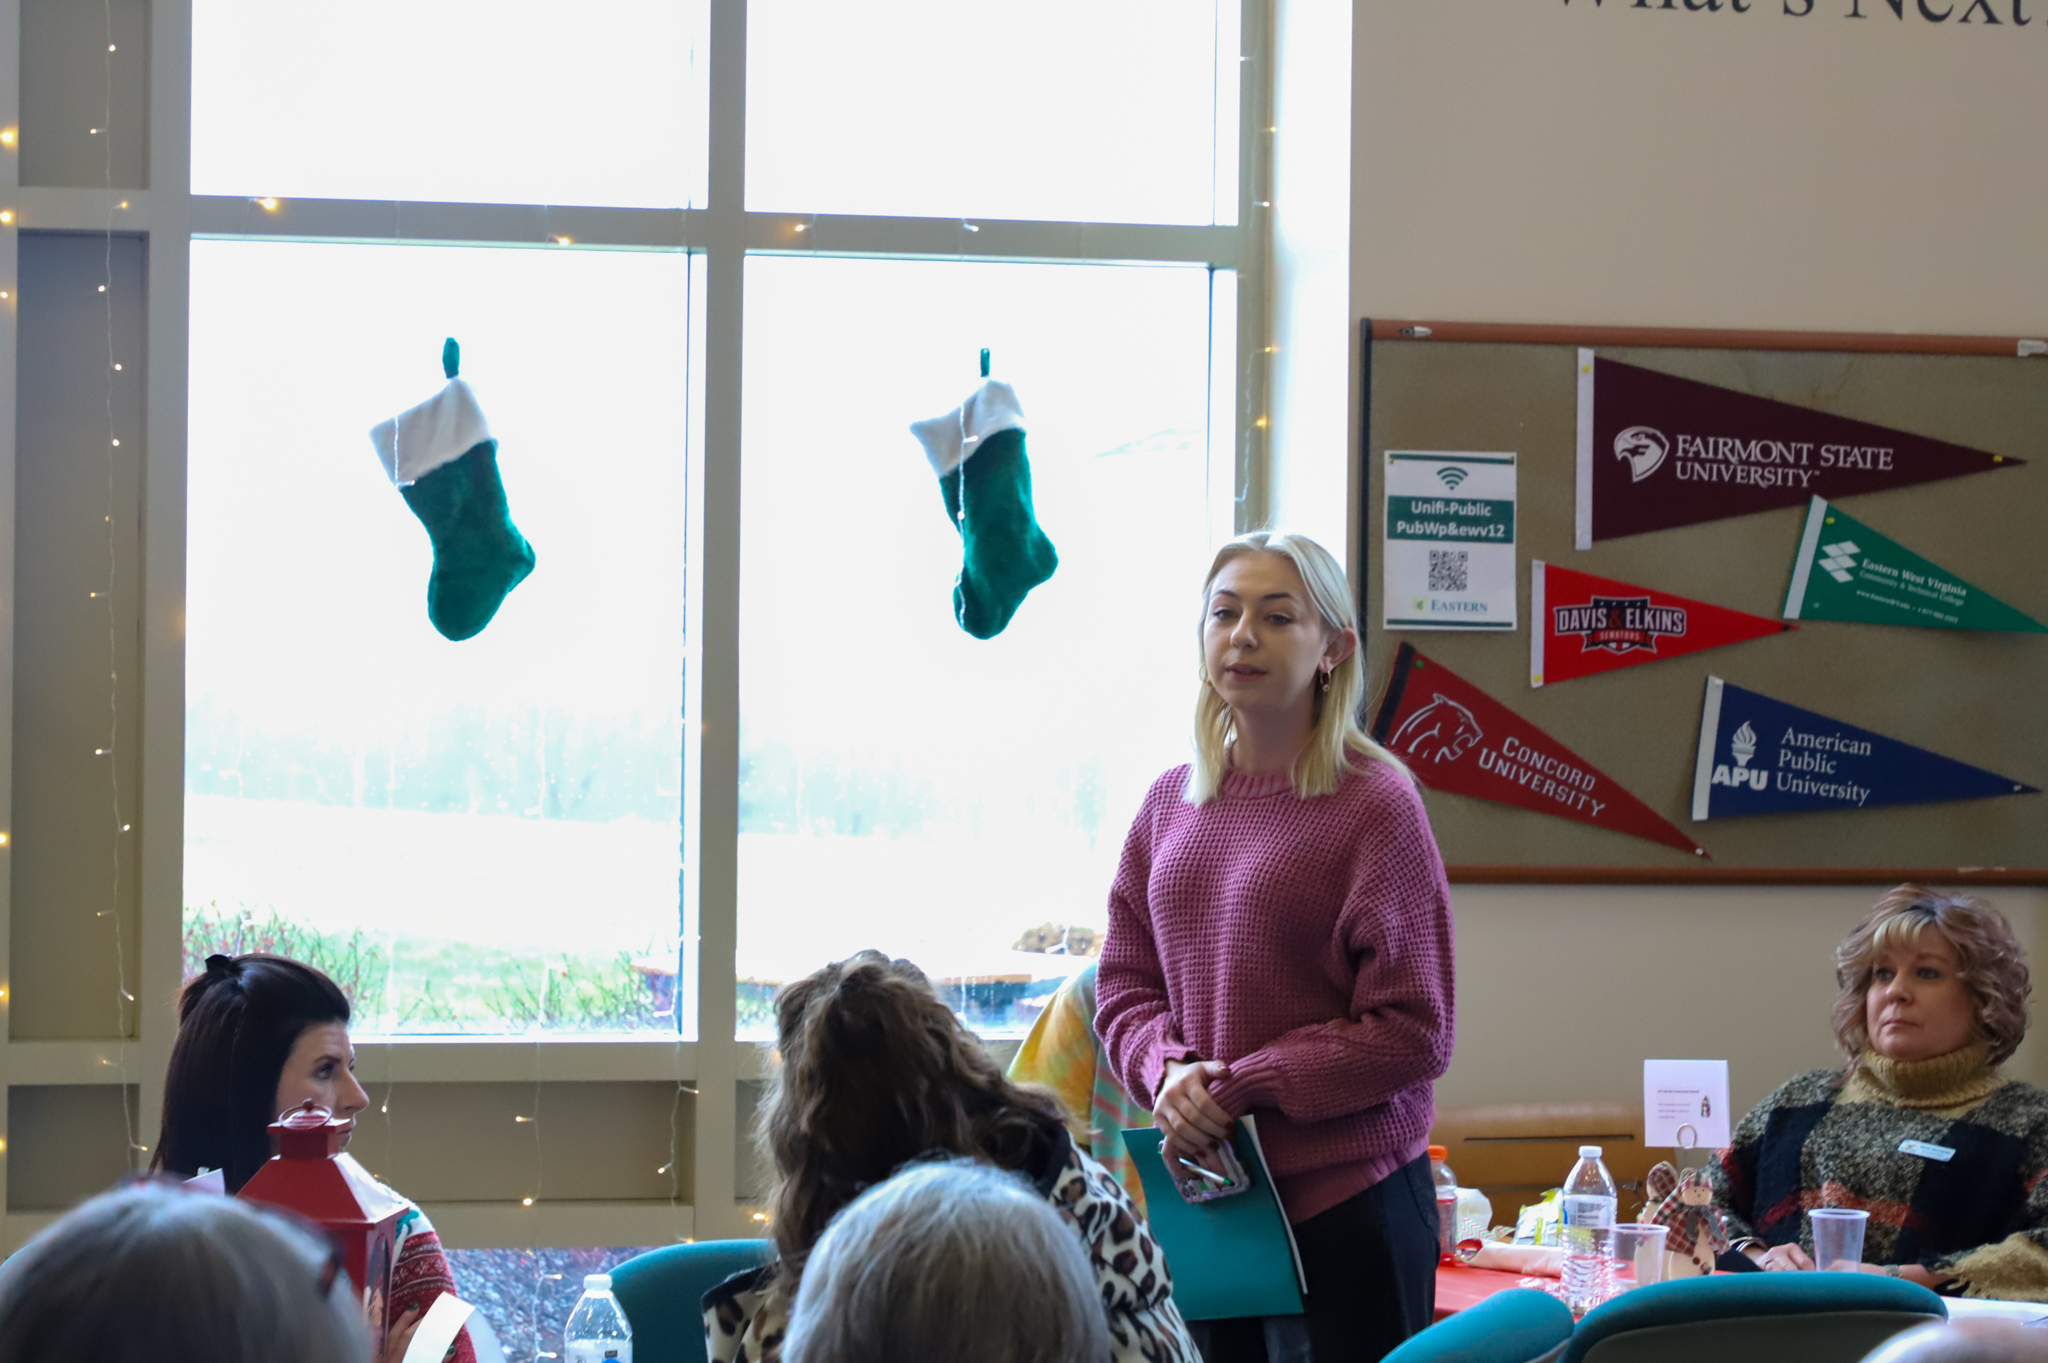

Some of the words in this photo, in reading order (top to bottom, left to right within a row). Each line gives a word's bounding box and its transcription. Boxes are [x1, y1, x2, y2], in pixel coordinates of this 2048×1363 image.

[1676, 435, 1813, 465] FAIRMONT
[1820, 444, 1893, 470] STATE
[1676, 461, 1813, 488] UNIVERSITY
[1411, 501, 1492, 516] Unifi-Public
[1397, 521, 1505, 538] PubWp&ewv12
[1862, 558, 1899, 577] Eastern
[1902, 569, 1925, 585] West
[1928, 577, 1967, 597] Virginia
[1431, 599, 1488, 612] EASTERN
[1559, 608, 1607, 631] DAVIS
[1608, 608, 1624, 629] &
[1626, 608, 1683, 633] ELKINS
[1599, 631, 1640, 640] SENATORS
[1781, 727, 1872, 756] American
[1502, 737, 1596, 791] CONCORD
[1778, 749, 1837, 774] Public
[1478, 747, 1606, 817] UNIVERSITY
[1711, 764, 1769, 791] APU
[1776, 772, 1870, 807] University
